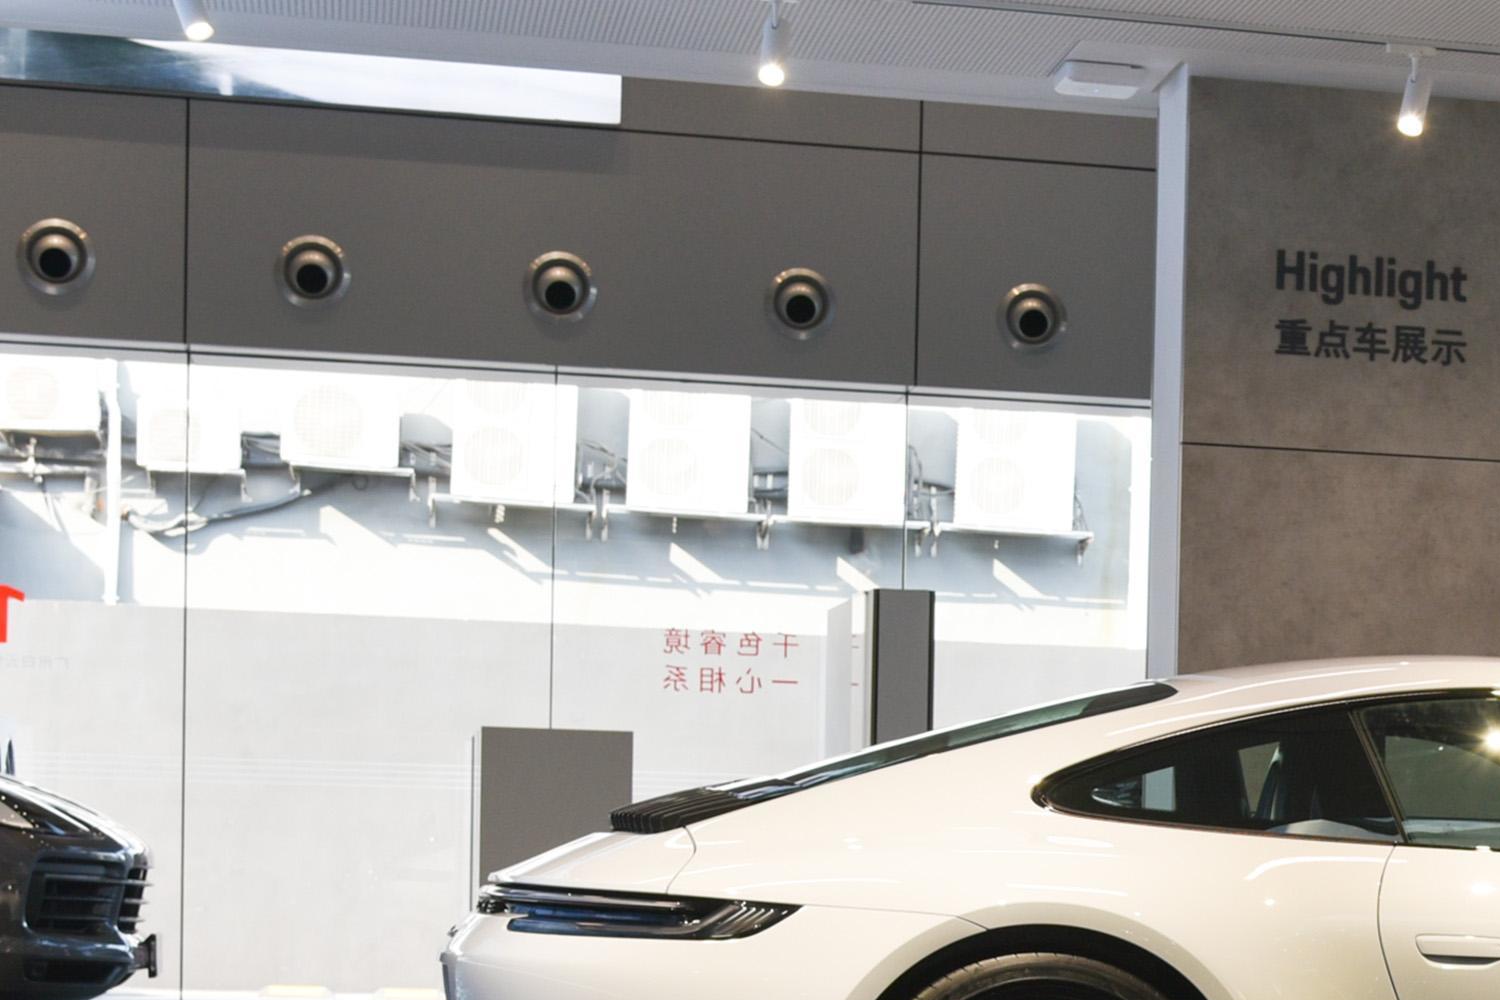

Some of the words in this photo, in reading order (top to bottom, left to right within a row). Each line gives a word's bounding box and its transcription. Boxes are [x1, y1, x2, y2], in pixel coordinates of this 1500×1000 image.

[1276, 249, 1468, 310] Highlight
[1275, 318, 1467, 366] 重点车展示
